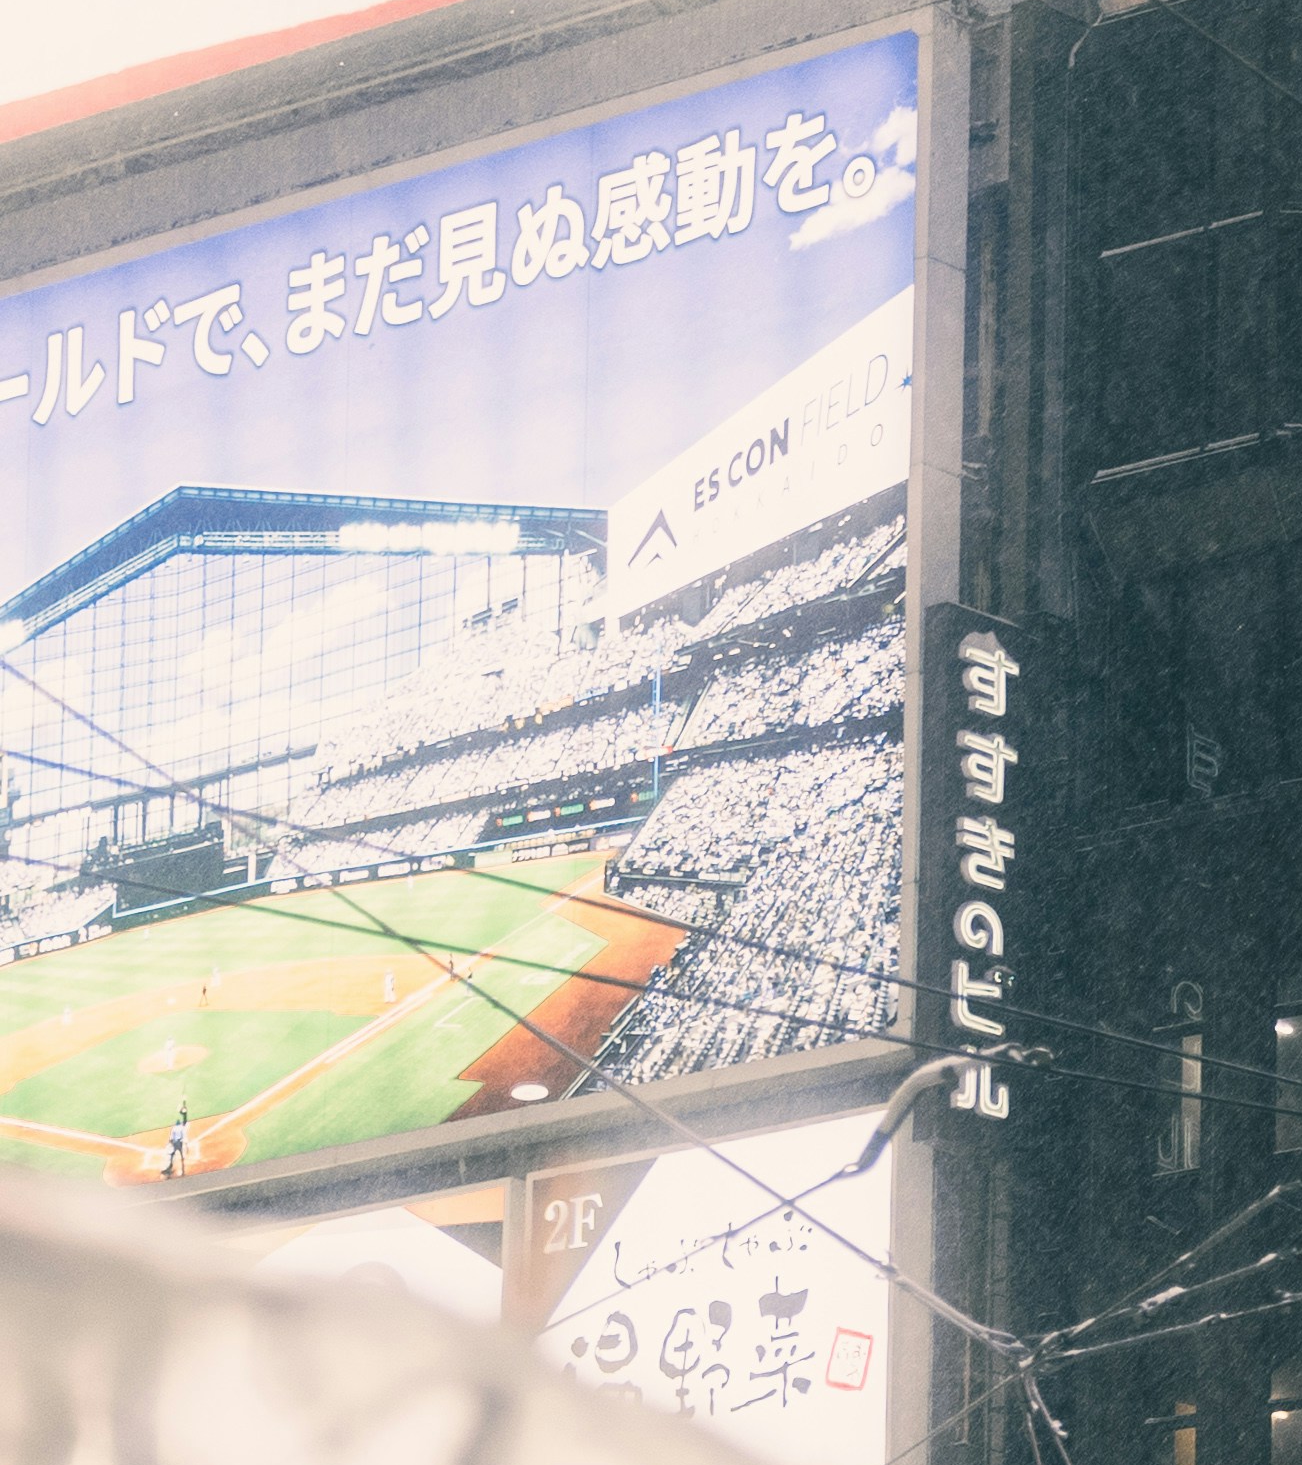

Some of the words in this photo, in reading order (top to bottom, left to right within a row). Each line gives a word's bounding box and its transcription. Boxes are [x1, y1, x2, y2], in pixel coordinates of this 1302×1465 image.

[801, 354, 889, 446] FIELD
[693, 423, 885, 545] OKKAIDO
[543, 1192, 603, 1254] 2F
